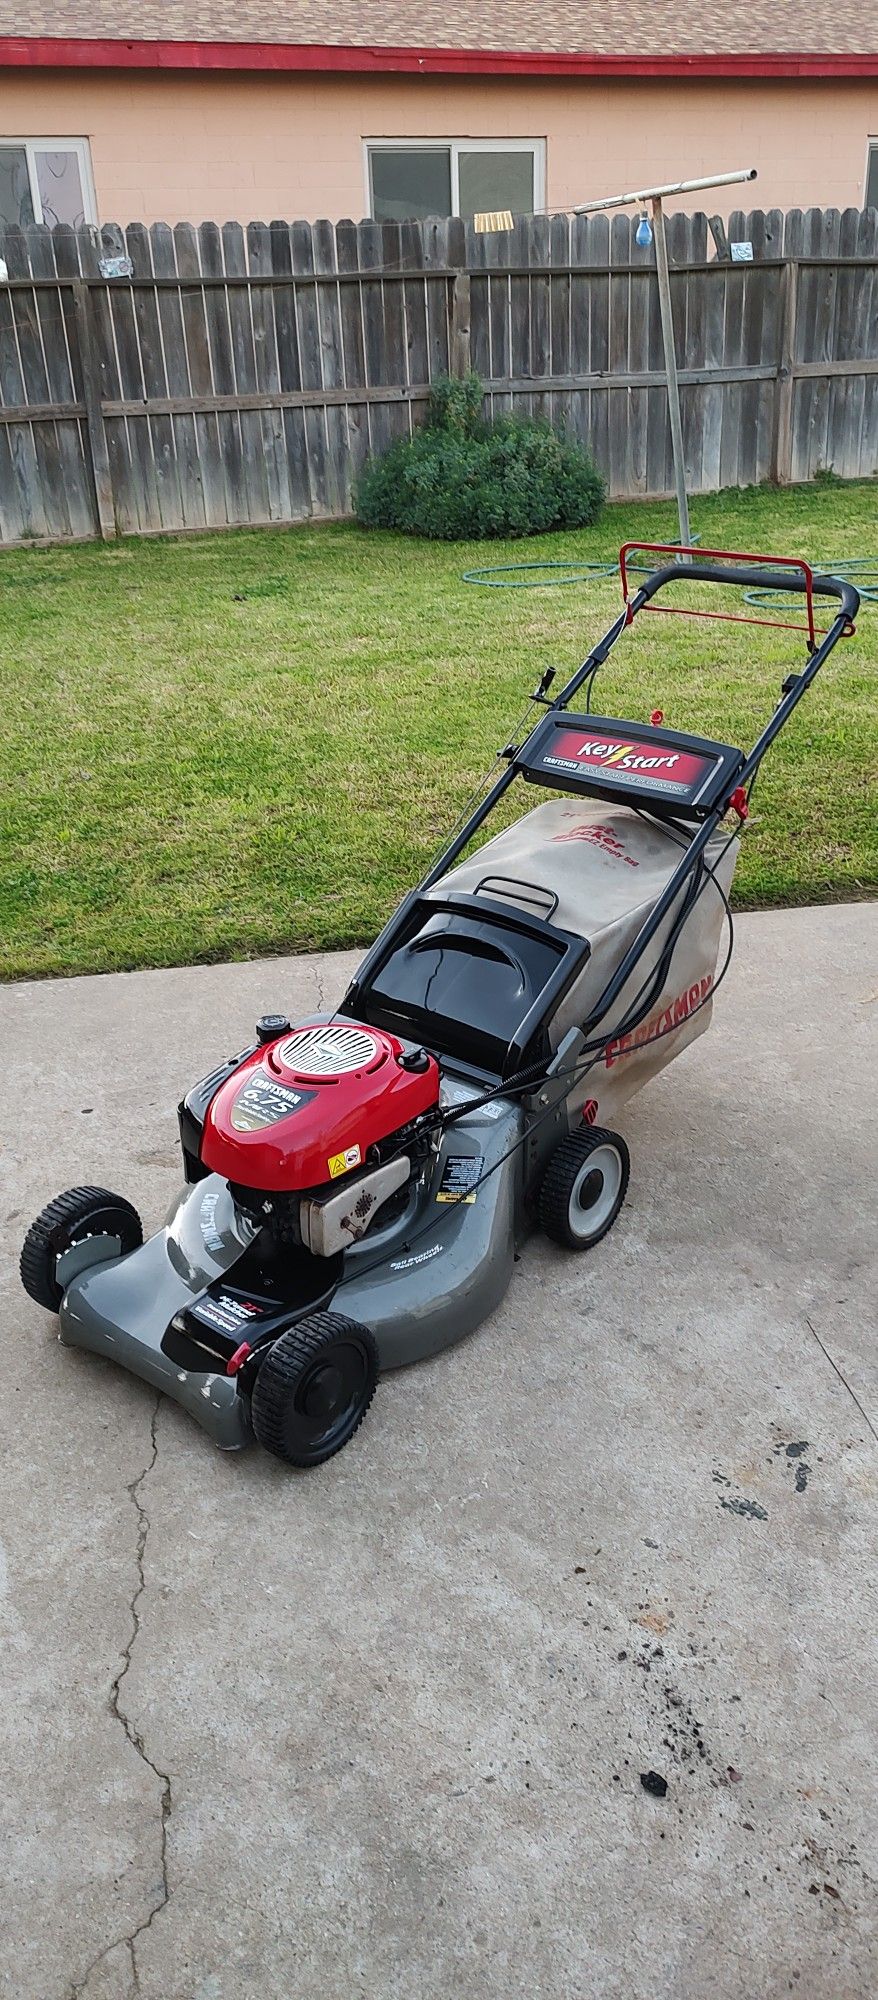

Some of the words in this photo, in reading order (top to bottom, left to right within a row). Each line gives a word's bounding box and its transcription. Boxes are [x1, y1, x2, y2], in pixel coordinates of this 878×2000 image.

[577, 741, 622, 758] Key
[543, 756, 578, 769] CRAFTSMAN
[616, 754, 680, 769] Start
[626, 775, 690, 793] PERFORMANCE
[599, 843, 624, 858] Empty
[623, 856, 640, 867] Bag
[243, 1089, 294, 1113] 6.75
[251, 1078, 302, 1105] CRAFTSMAN
[200, 1193, 226, 1252] CRAFTSMAN
